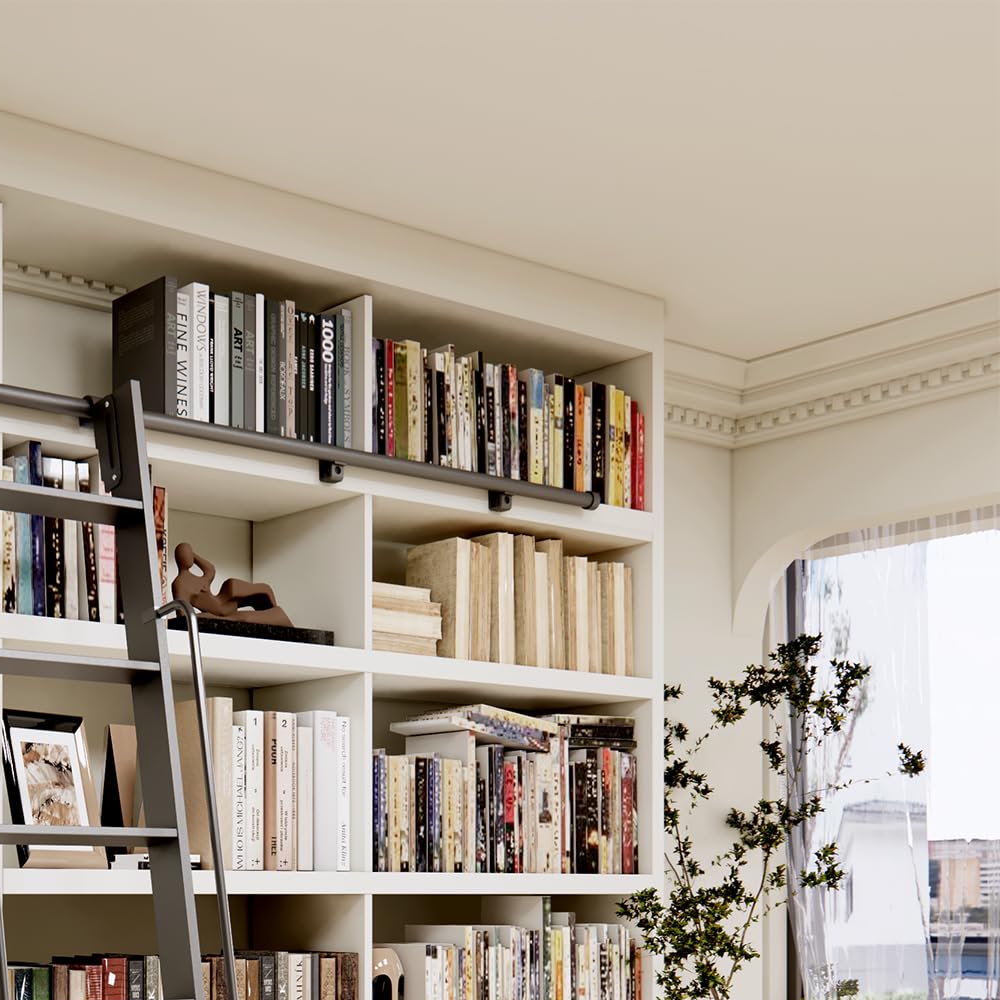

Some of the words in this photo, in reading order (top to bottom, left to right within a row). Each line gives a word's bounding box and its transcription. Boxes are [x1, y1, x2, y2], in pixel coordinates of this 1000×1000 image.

[177, 313, 188, 352] FINE
[196, 290, 207, 352] WINDOWS
[234, 328, 243, 353] ART
[246, 330, 255, 355] ART
[322, 319, 334, 364] 1000
[177, 360, 188, 417] WINES
[236, 774, 244, 825] MICHAEL
[236, 826, 244, 838] IS
[236, 840, 244, 870] WHO
